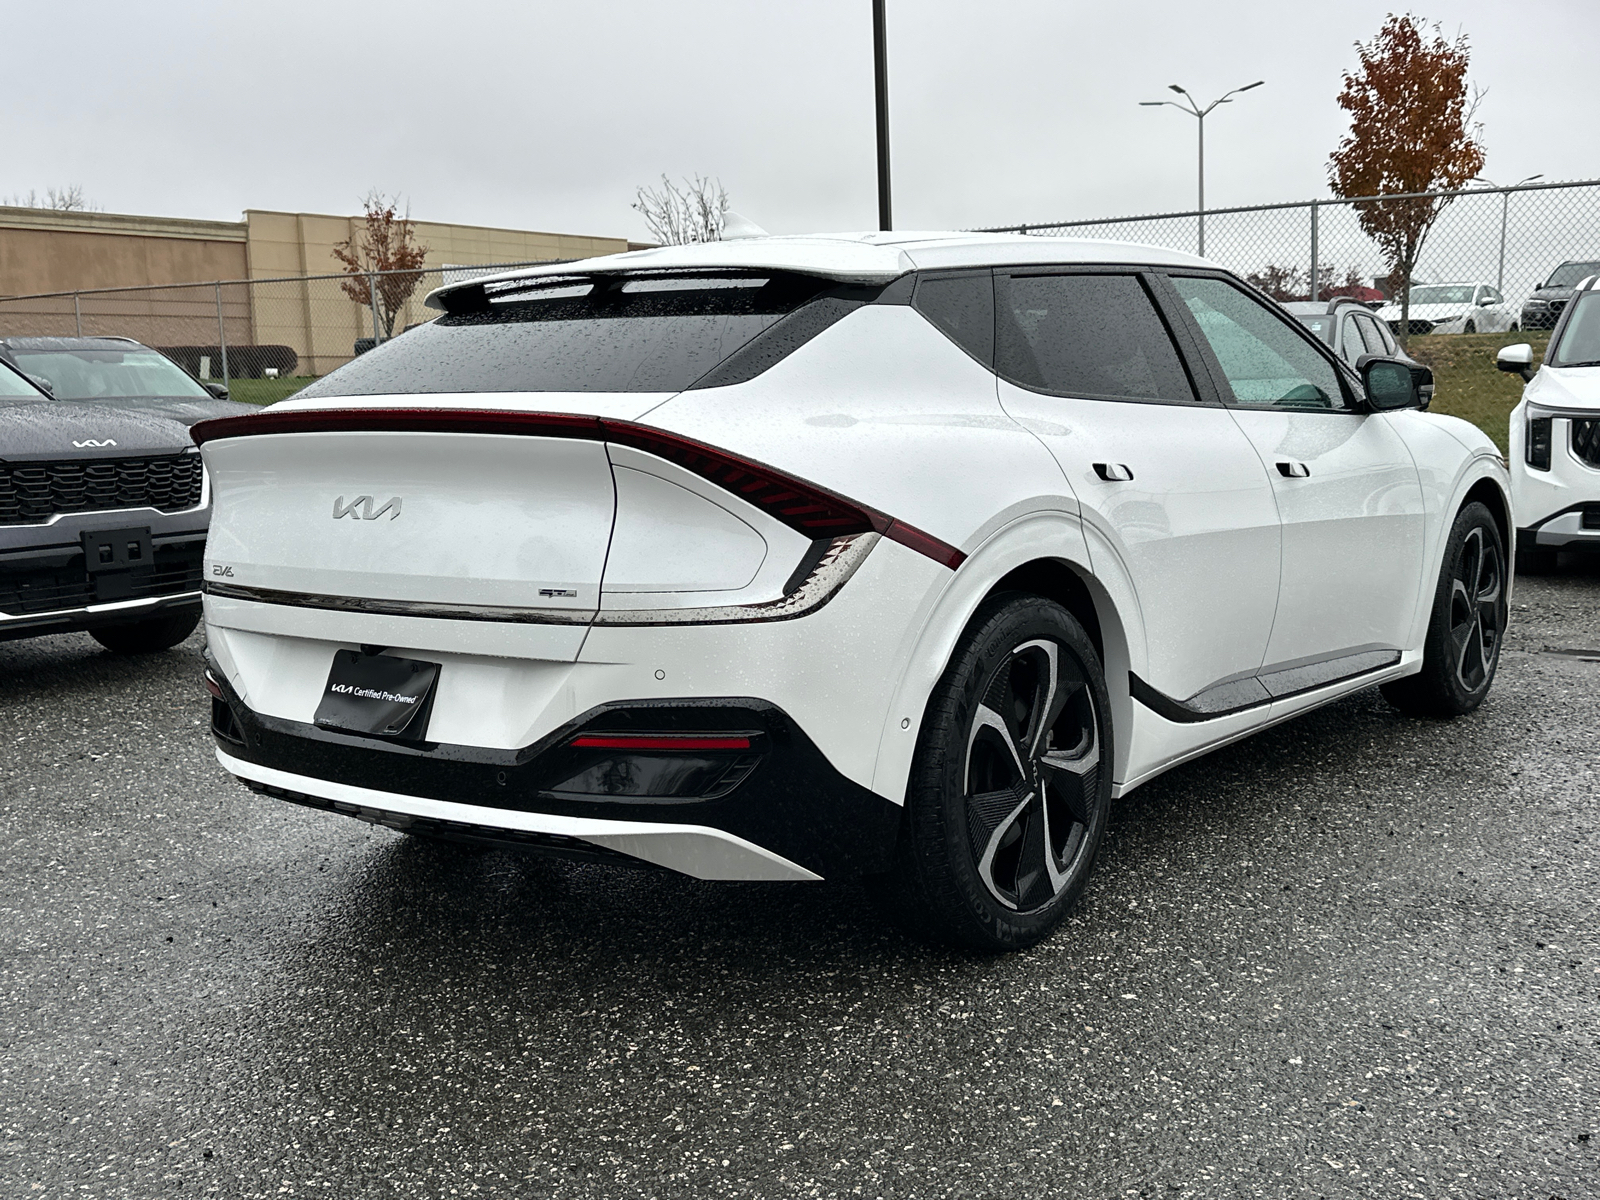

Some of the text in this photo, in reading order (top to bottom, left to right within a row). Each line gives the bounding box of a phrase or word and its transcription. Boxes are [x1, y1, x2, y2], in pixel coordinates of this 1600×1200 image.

[332, 495, 402, 521] KIA
[212, 564, 234, 578] EV6
[331, 683, 417, 704] KIA Certified Pre-Owned
